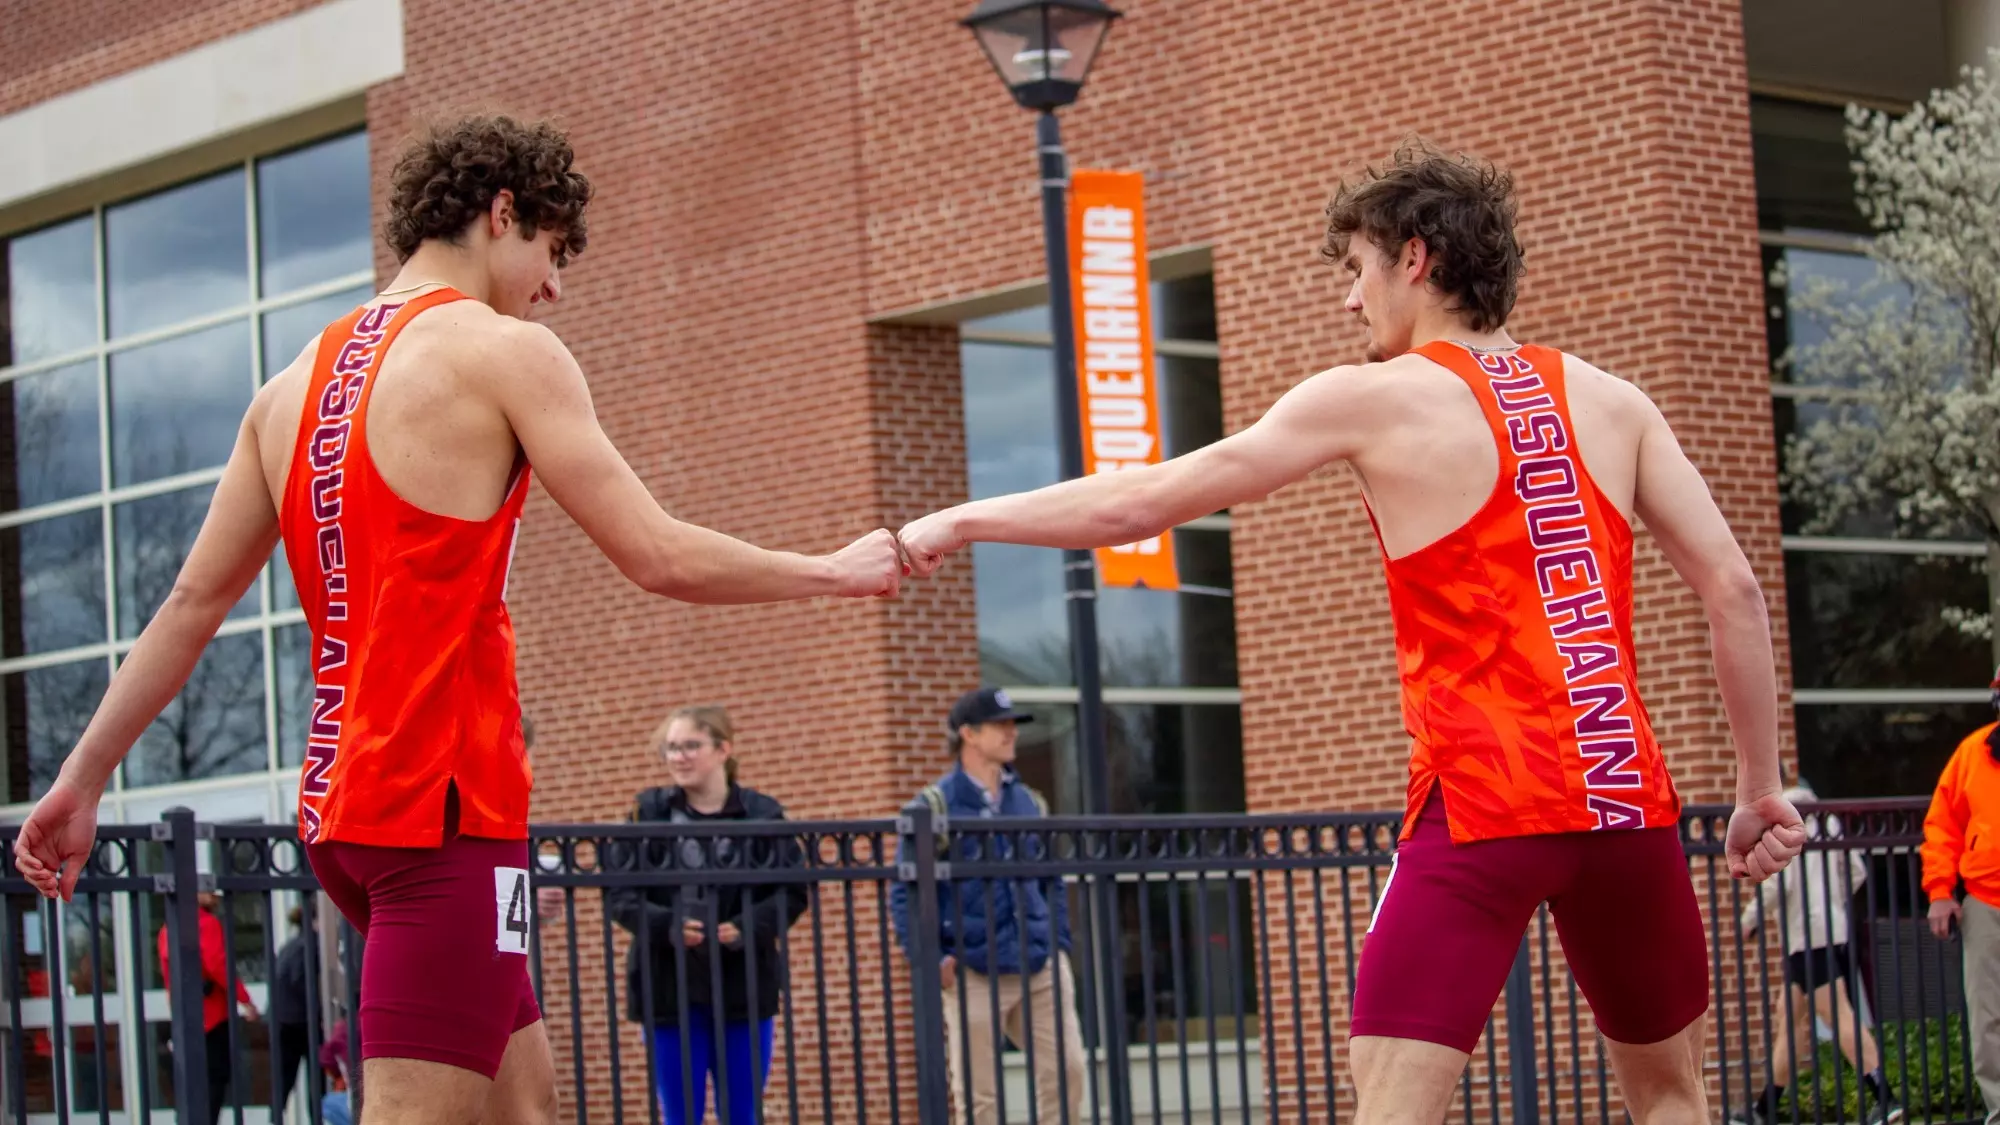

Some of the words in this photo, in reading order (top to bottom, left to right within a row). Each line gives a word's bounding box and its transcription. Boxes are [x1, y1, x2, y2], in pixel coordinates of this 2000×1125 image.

[1081, 204, 1161, 556] QUEHANNA
[1469, 351, 1646, 831] SUSQUEHANNA
[506, 873, 528, 949] 4
